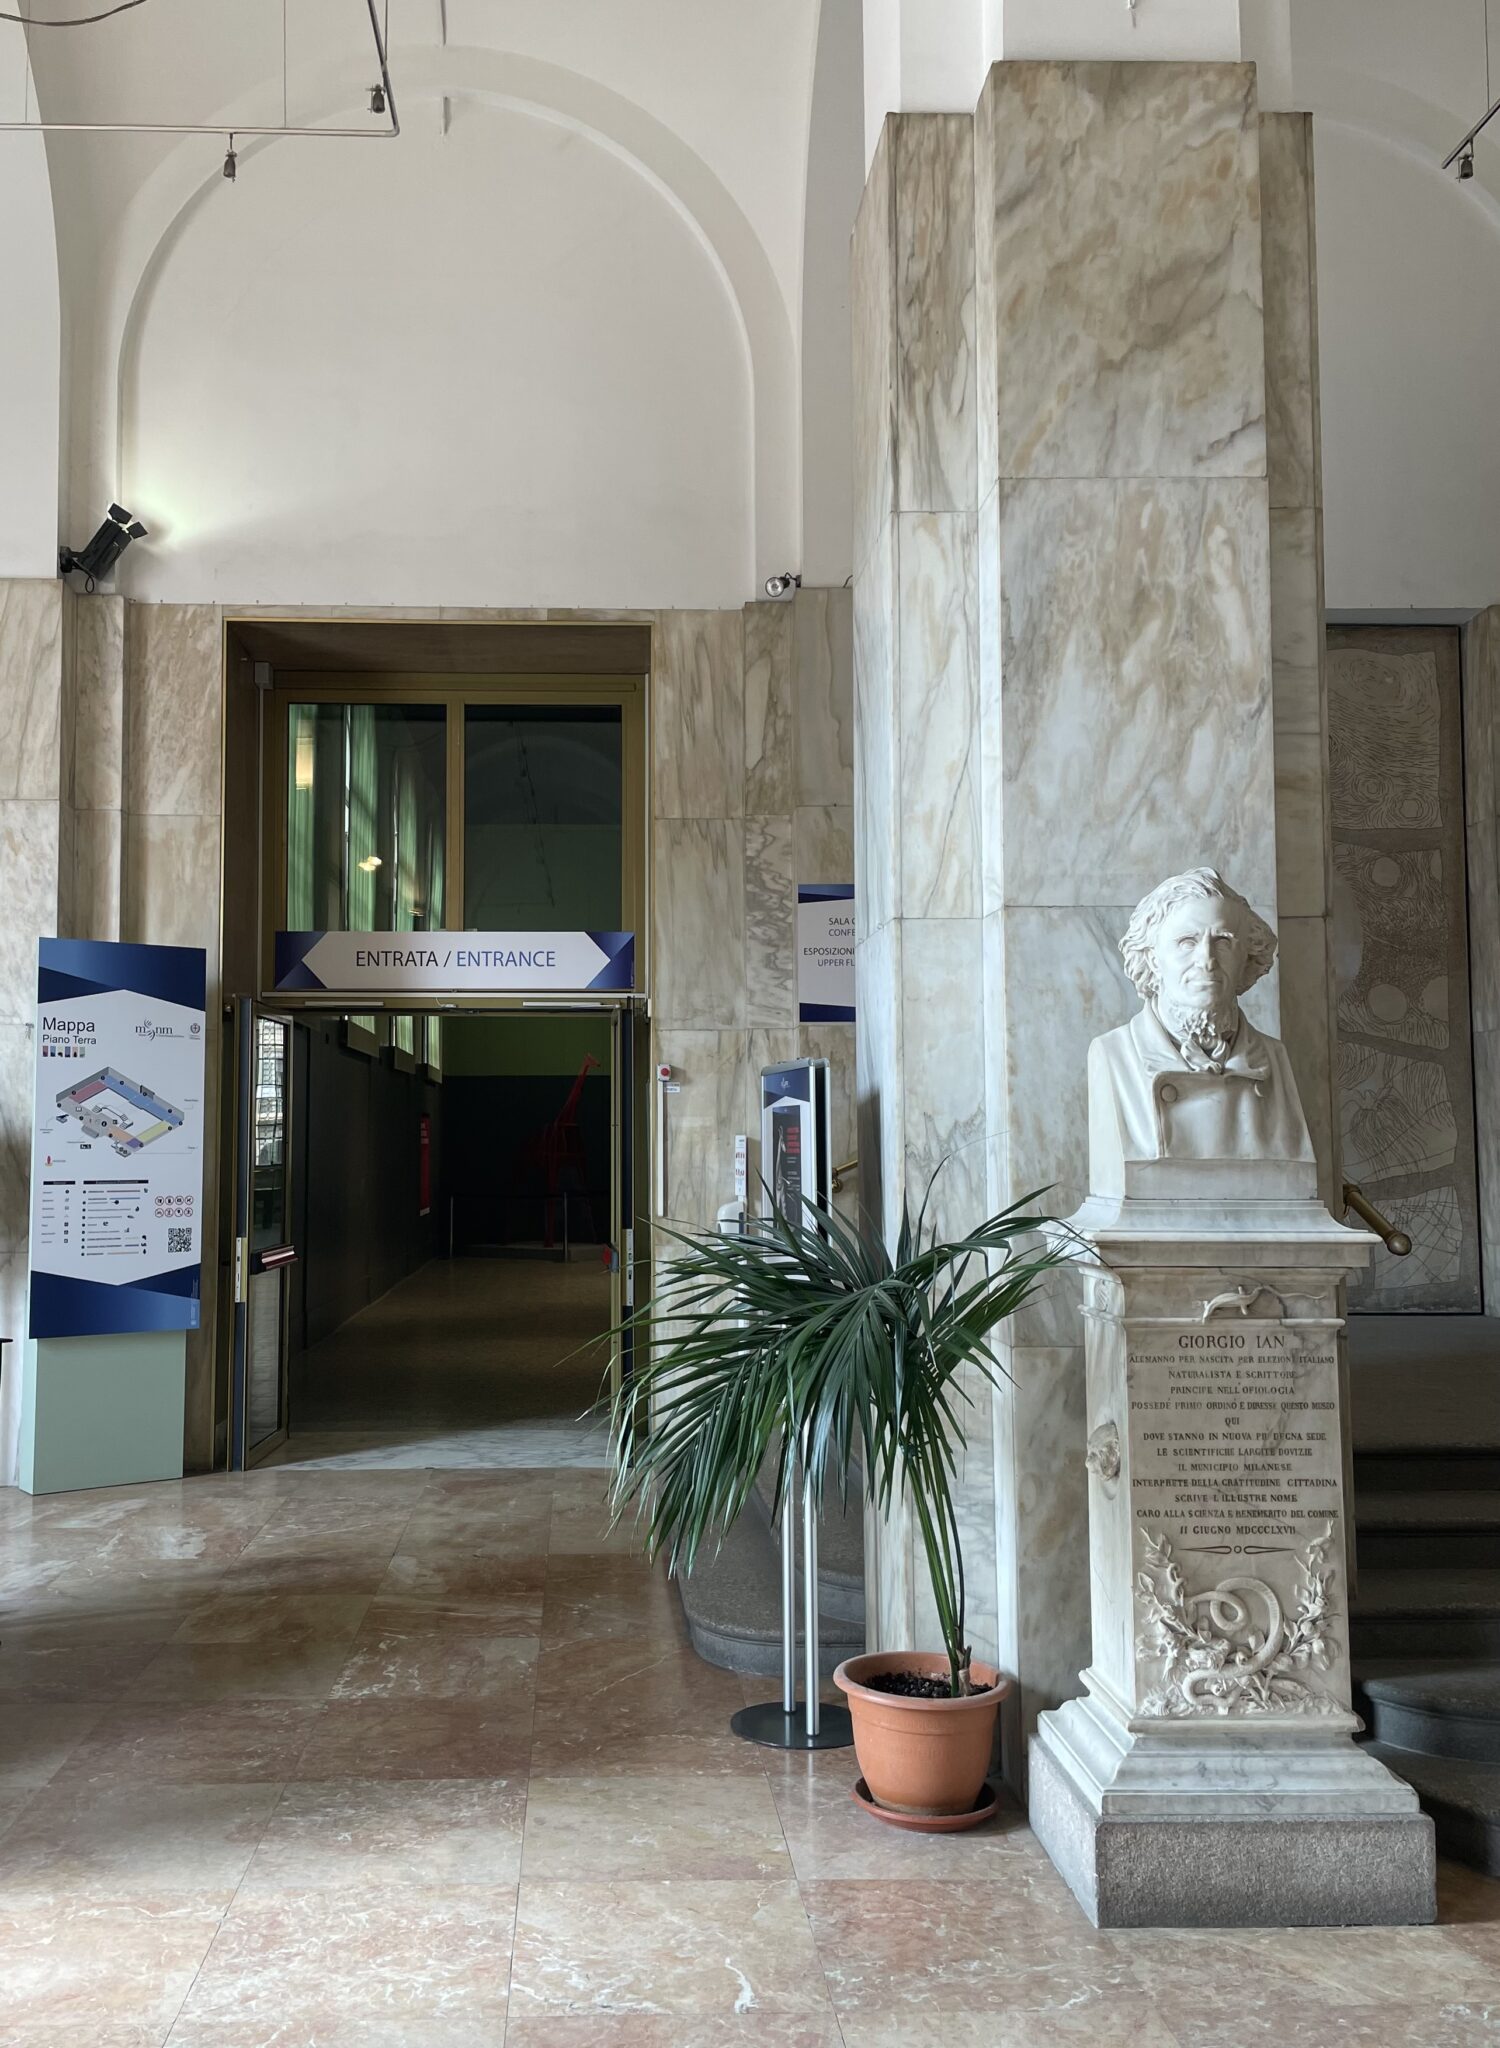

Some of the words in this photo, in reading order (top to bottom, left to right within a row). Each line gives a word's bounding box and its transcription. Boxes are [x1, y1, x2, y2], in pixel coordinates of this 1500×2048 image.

[828, 917, 850, 926] SALA
[355, 950, 439, 967] ENTRATA
[443, 950, 452, 968] /
[456, 950, 556, 967] ENTRANCE
[817, 958, 845, 967] UPPER
[42, 1016, 95, 1035] Mappa
[42, 1034, 70, 1044] Piano
[72, 1035, 97, 1045] Terra
[1178, 1335, 1245, 1349] GIORGIO
[1256, 1335, 1285, 1349] IAN
[1129, 1355, 1175, 1363] ALEMANNO
[1179, 1355, 1195, 1363] PER
[1199, 1355, 1234, 1363] NASCITA
[1238, 1355, 1254, 1363] PER
[1299, 1355, 1335, 1363] ITALIANO
[1168, 1370, 1232, 1379] NATURALISTA
[1236, 1370, 1242, 1379] E
[1246, 1370, 1296, 1379] SCRITTORE
[1170, 1386, 1214, 1394] PRINCIPE
[1175, 1402, 1203, 1410] PRIMO
[1240, 1402, 1245, 1410] E
[1247, 1402, 1277, 1410] DIRESSE
[1280, 1402, 1309, 1412] QUESTO
[1311, 1402, 1335, 1410] MUSEO
[1225, 1417, 1240, 1428] QUI
[1156, 1448, 1168, 1456] LE
[1172, 1448, 1235, 1456] SCIENTIFICHE
[1238, 1448, 1276, 1456] LARGITE
[1278, 1448, 1313, 1456] DOVIZIE
[1178, 1464, 1188, 1472] IL
[1190, 1464, 1239, 1472] MUNICIPIO
[1243, 1464, 1293, 1472] MILANESE
[1132, 1479, 1189, 1487] INTERPRETE
[1191, 1479, 1219, 1487] DELLA
[1221, 1479, 1281, 1487] GRATITUDINE
[1287, 1479, 1338, 1487] CITTADINA
[1175, 1494, 1209, 1502] SCRIVE
[1270, 1494, 1298, 1502] NOME
[1136, 1510, 1161, 1518] CARO
[1163, 1510, 1185, 1518] ALLA
[1188, 1510, 1225, 1518] SCIENZA
[1227, 1510, 1233, 1518] E
[1235, 1510, 1287, 1518] BENEMERITO
[1290, 1510, 1305, 1518] DEL
[1308, 1510, 1339, 1518] COMUNE
[1192, 1526, 1231, 1534] GIUGNO
